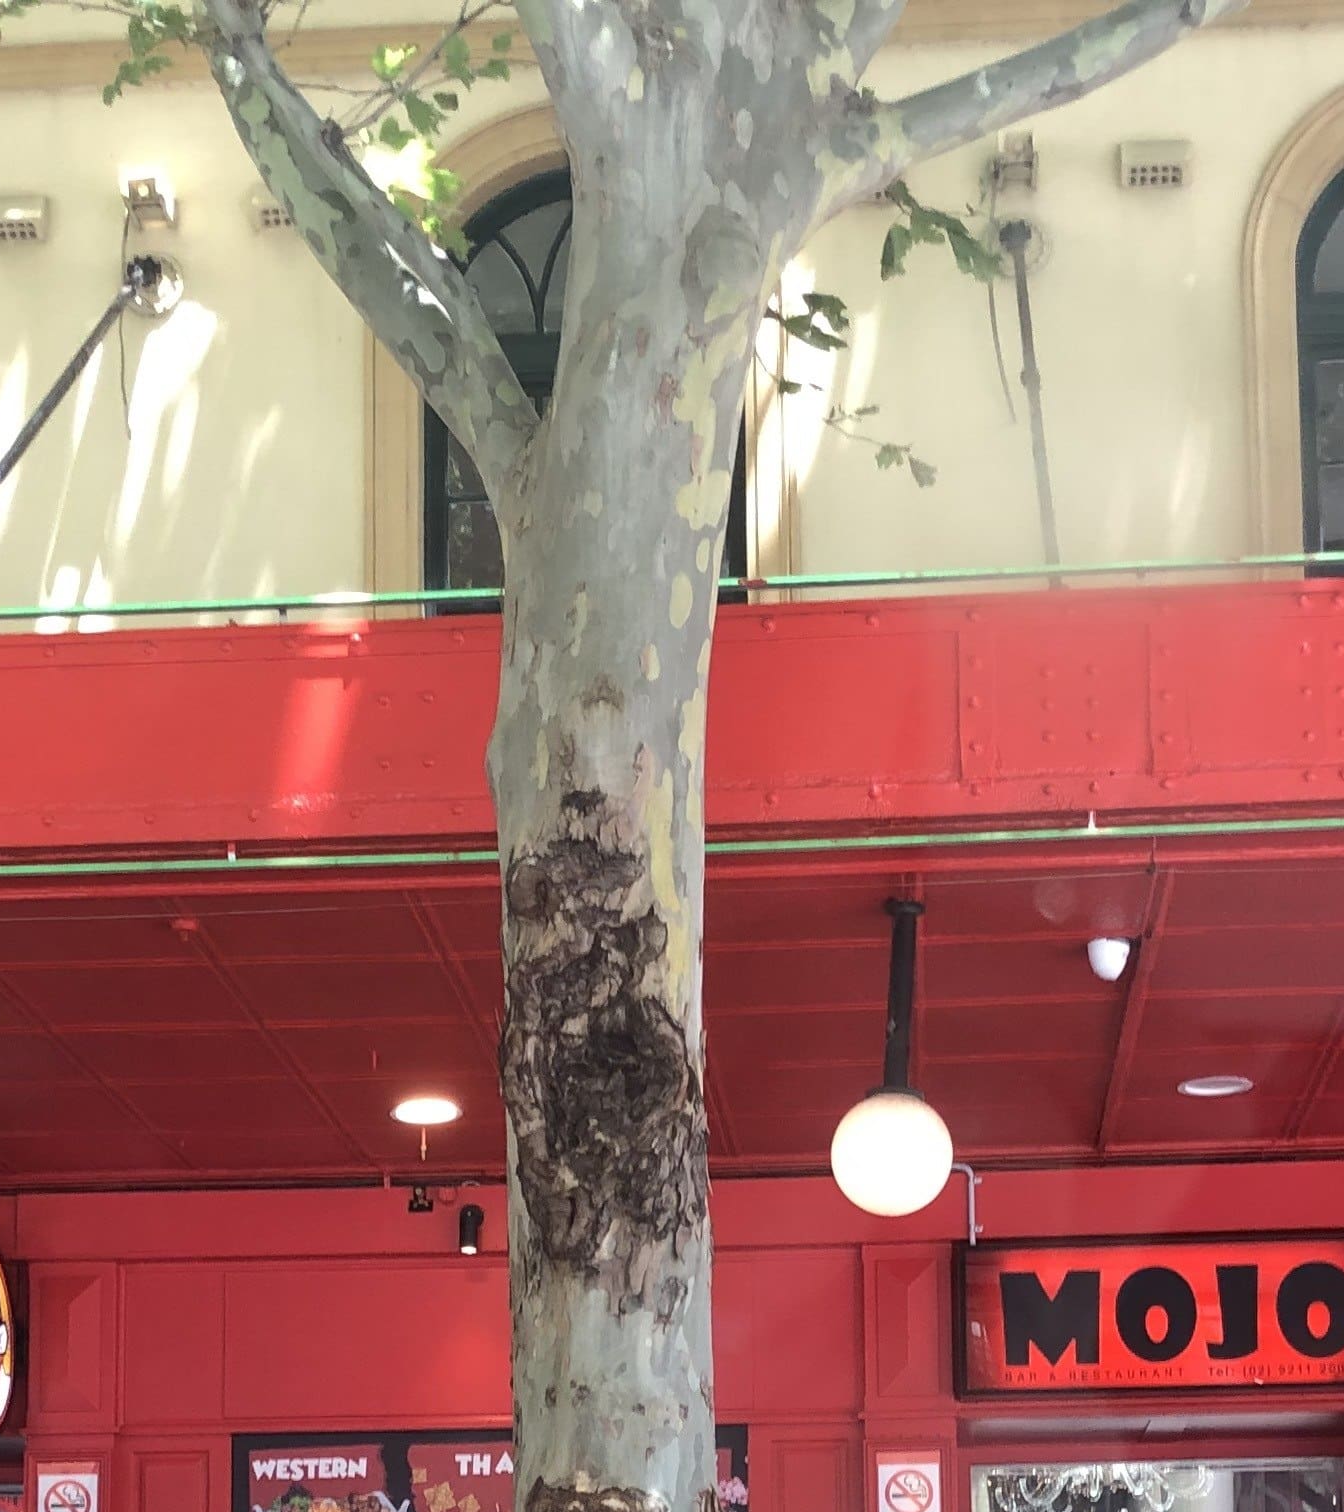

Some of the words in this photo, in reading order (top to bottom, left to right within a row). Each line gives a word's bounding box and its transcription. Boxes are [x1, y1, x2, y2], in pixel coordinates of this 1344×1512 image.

[1006, 1371, 1037, 1382] BAR
[1069, 1367, 1183, 1381] RESTAURANT
[252, 1457, 368, 1481] WESTERN
[455, 1451, 513, 1477] THA
